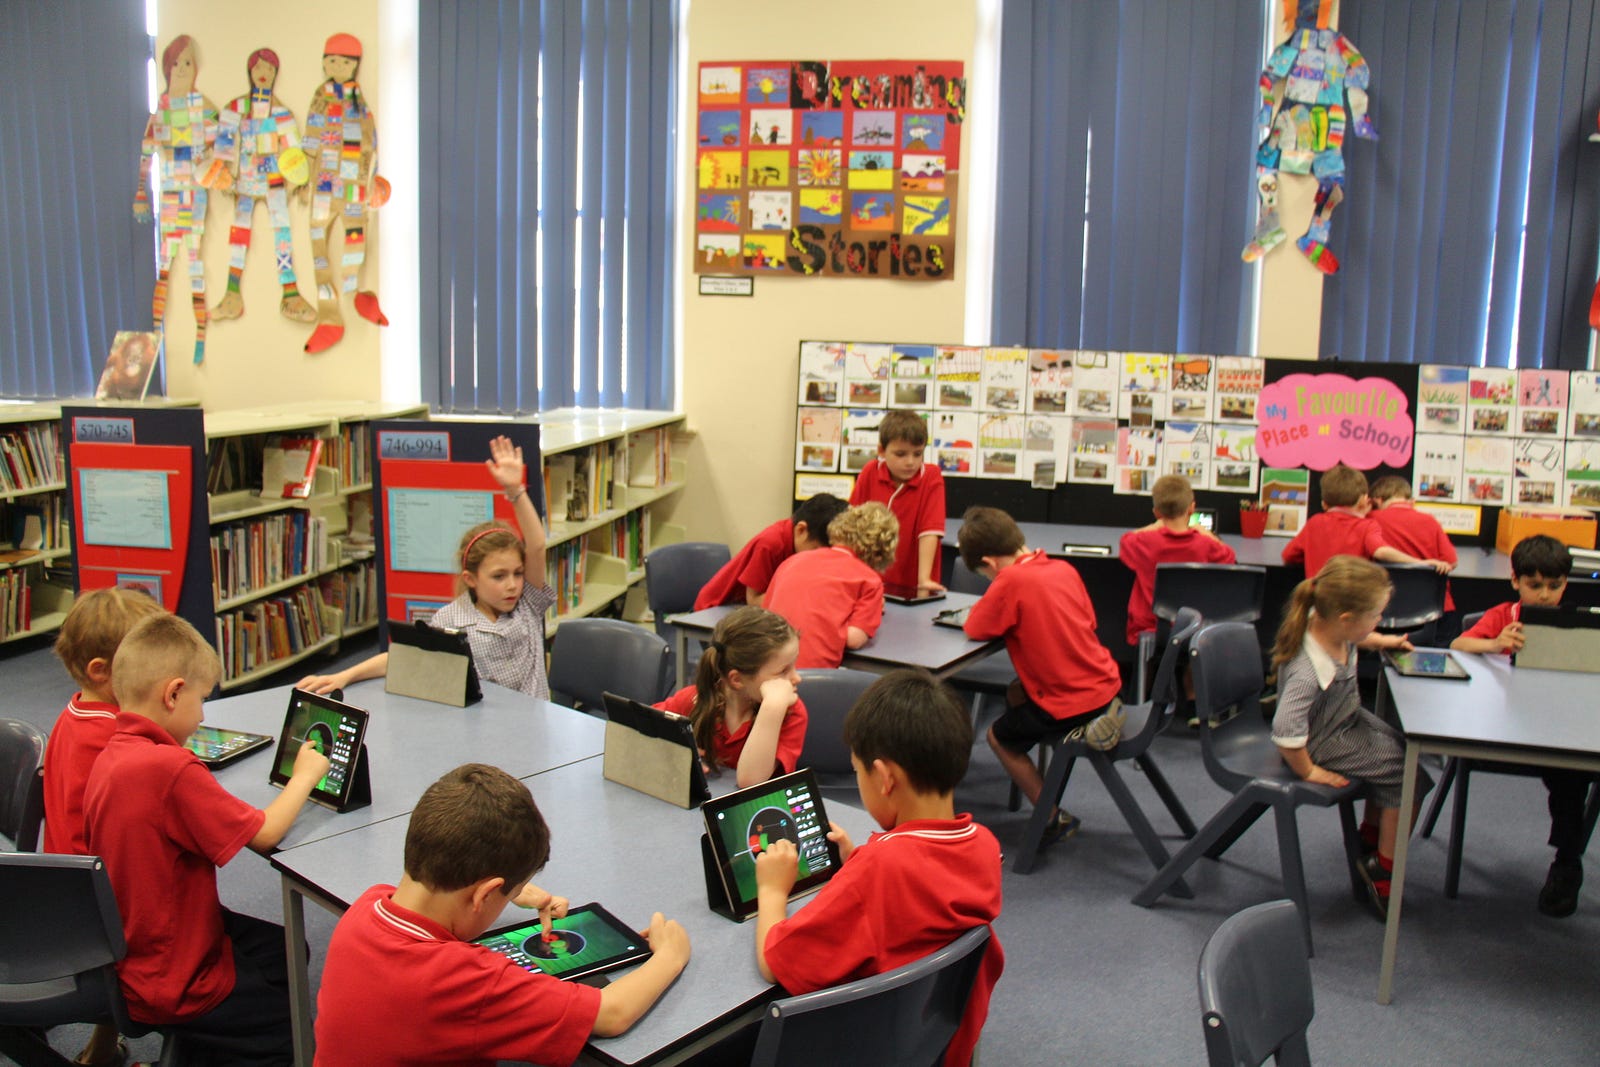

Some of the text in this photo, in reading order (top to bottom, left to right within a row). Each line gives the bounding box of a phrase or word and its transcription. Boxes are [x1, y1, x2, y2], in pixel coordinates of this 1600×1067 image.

[790, 61, 967, 124] Dreaming
[787, 224, 944, 276] Stories
[1265, 386, 1398, 421] My Favourite
[80, 424, 128, 439] 570-745
[385, 438, 442, 453] 746-994
[1262, 419, 1410, 453] Place at School
